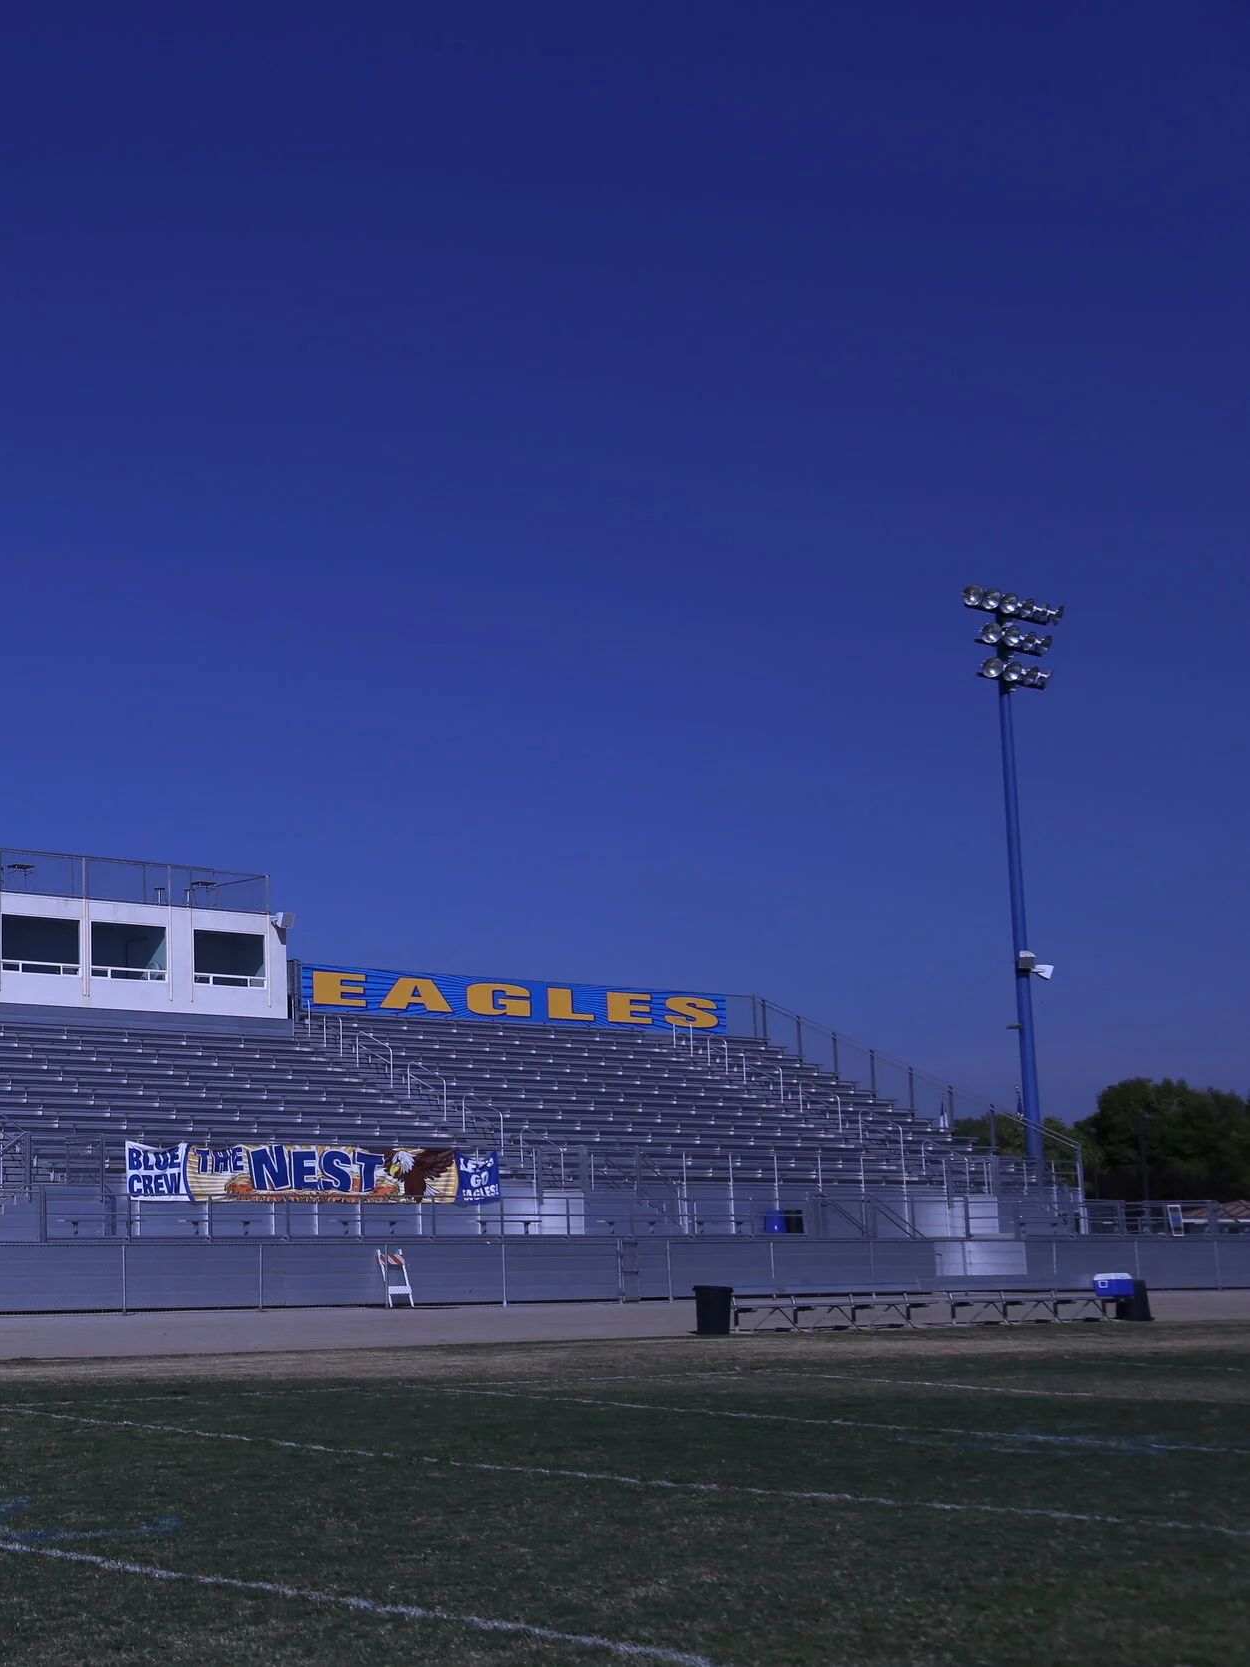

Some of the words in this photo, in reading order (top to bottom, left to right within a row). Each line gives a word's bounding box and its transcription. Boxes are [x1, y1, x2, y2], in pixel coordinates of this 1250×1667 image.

[311, 970, 720, 1029] EAGLES
[128, 1147, 181, 1171] BLUE
[193, 1146, 246, 1174] THE
[249, 1144, 386, 1192] NEST
[128, 1173, 181, 1198] CREW
[470, 1171, 489, 1188] GO
